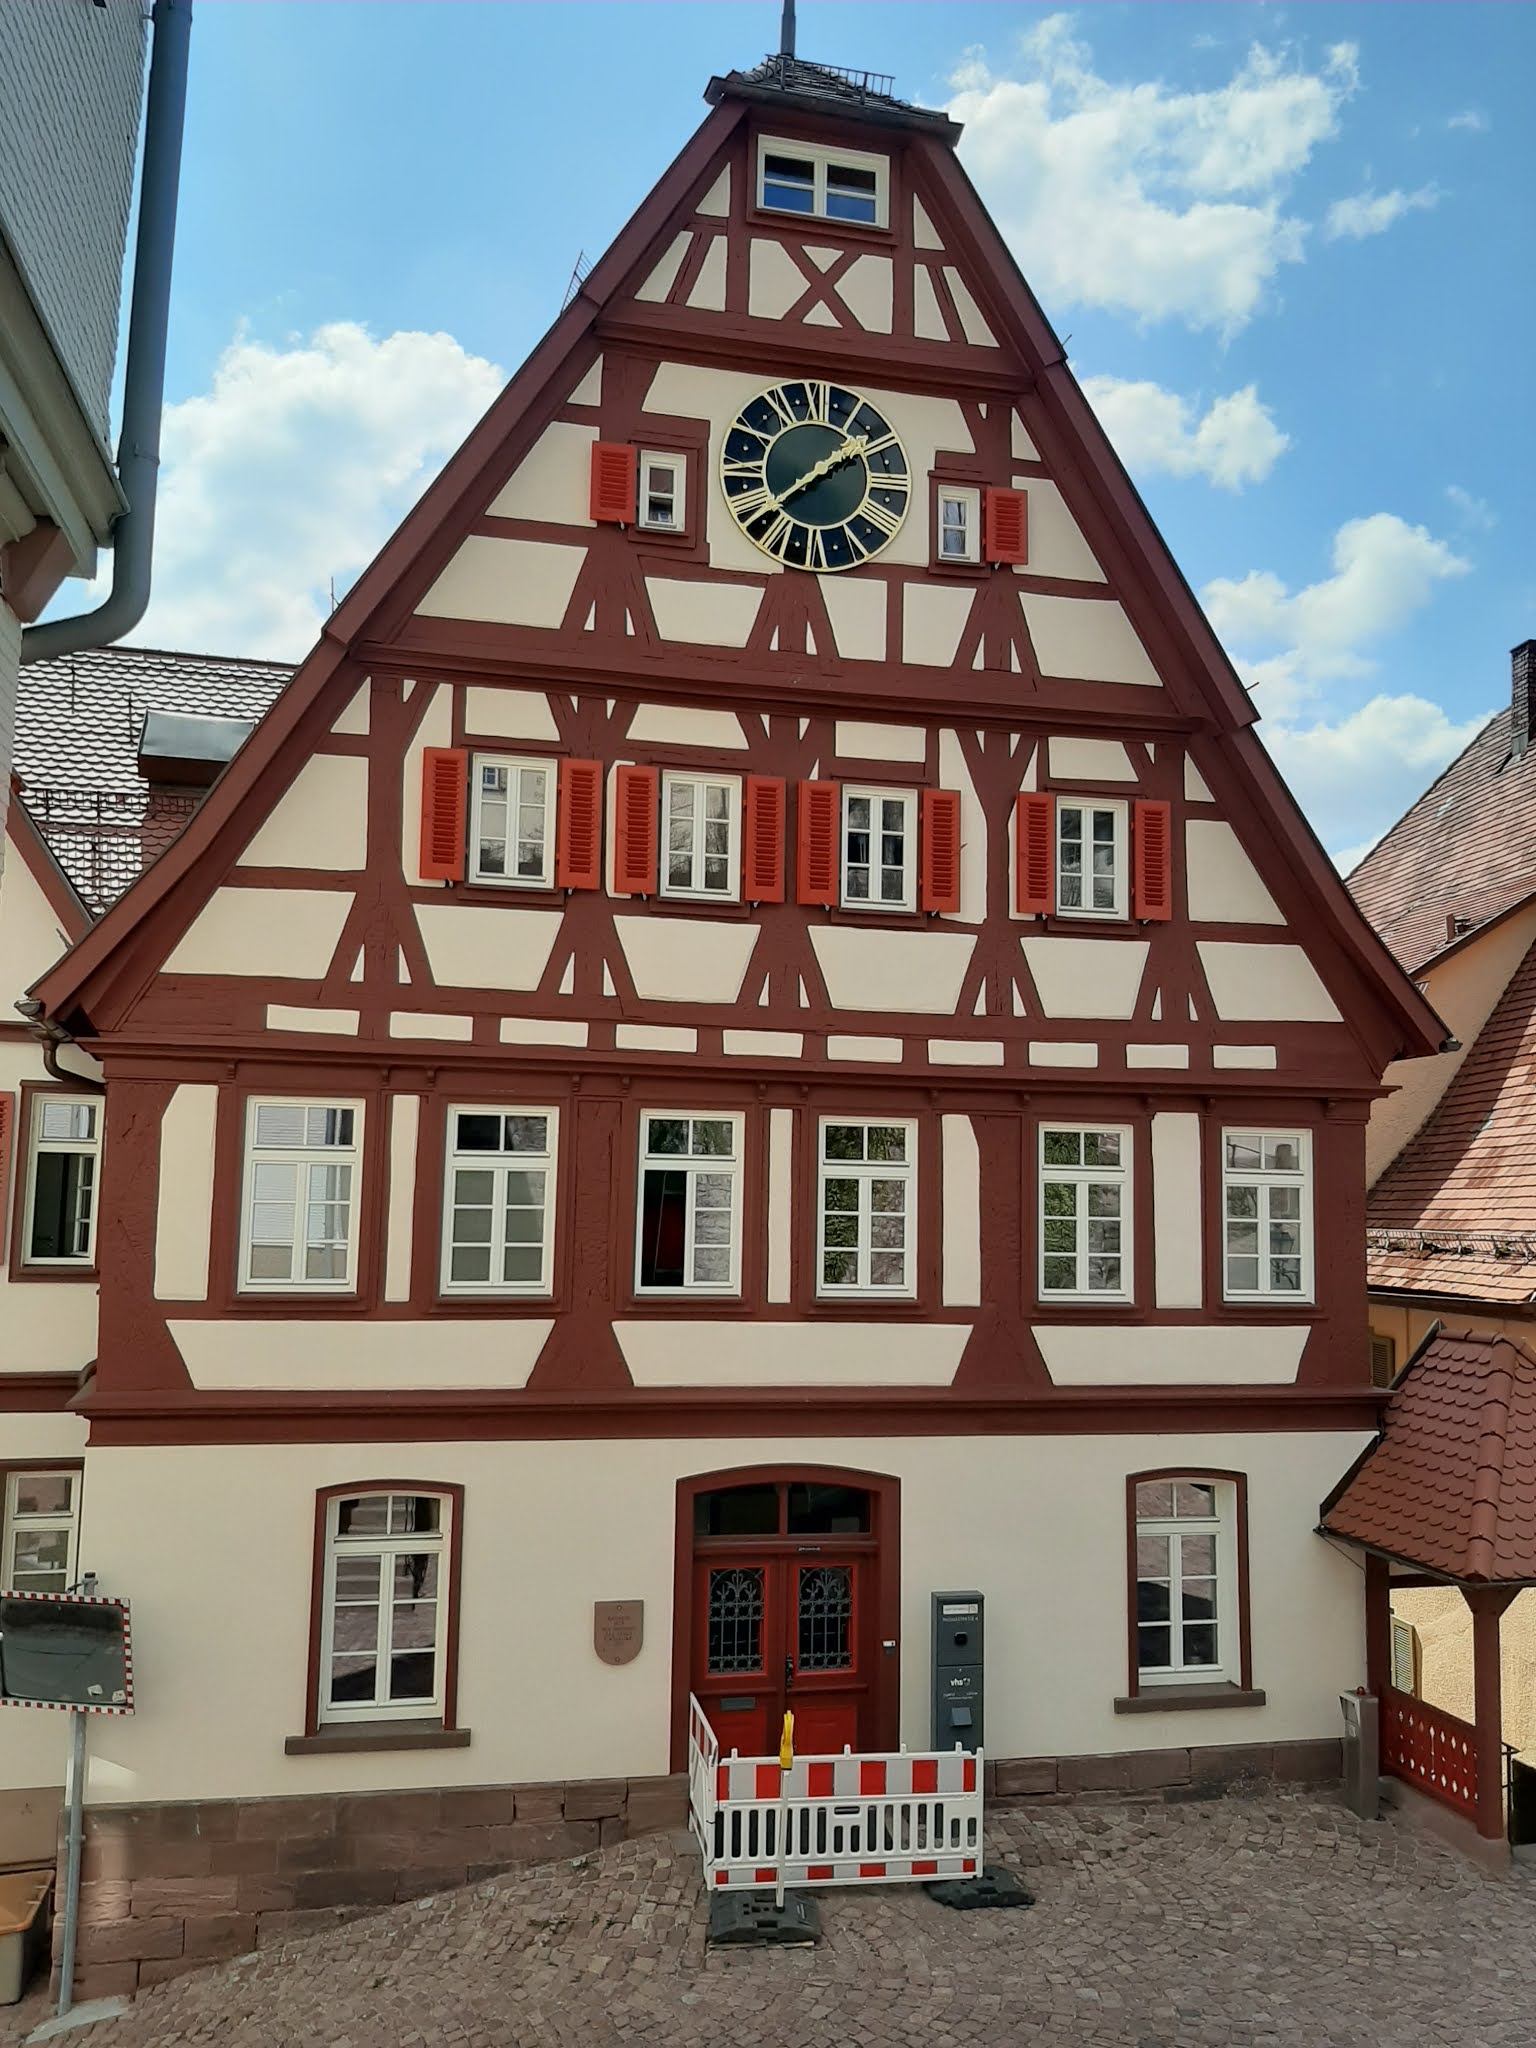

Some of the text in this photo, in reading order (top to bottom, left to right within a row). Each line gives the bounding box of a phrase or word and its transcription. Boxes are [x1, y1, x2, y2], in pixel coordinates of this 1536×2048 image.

[804, 382, 830, 422] XII
[870, 473, 909, 491] III
[950, 1678, 963, 1686] vhs
